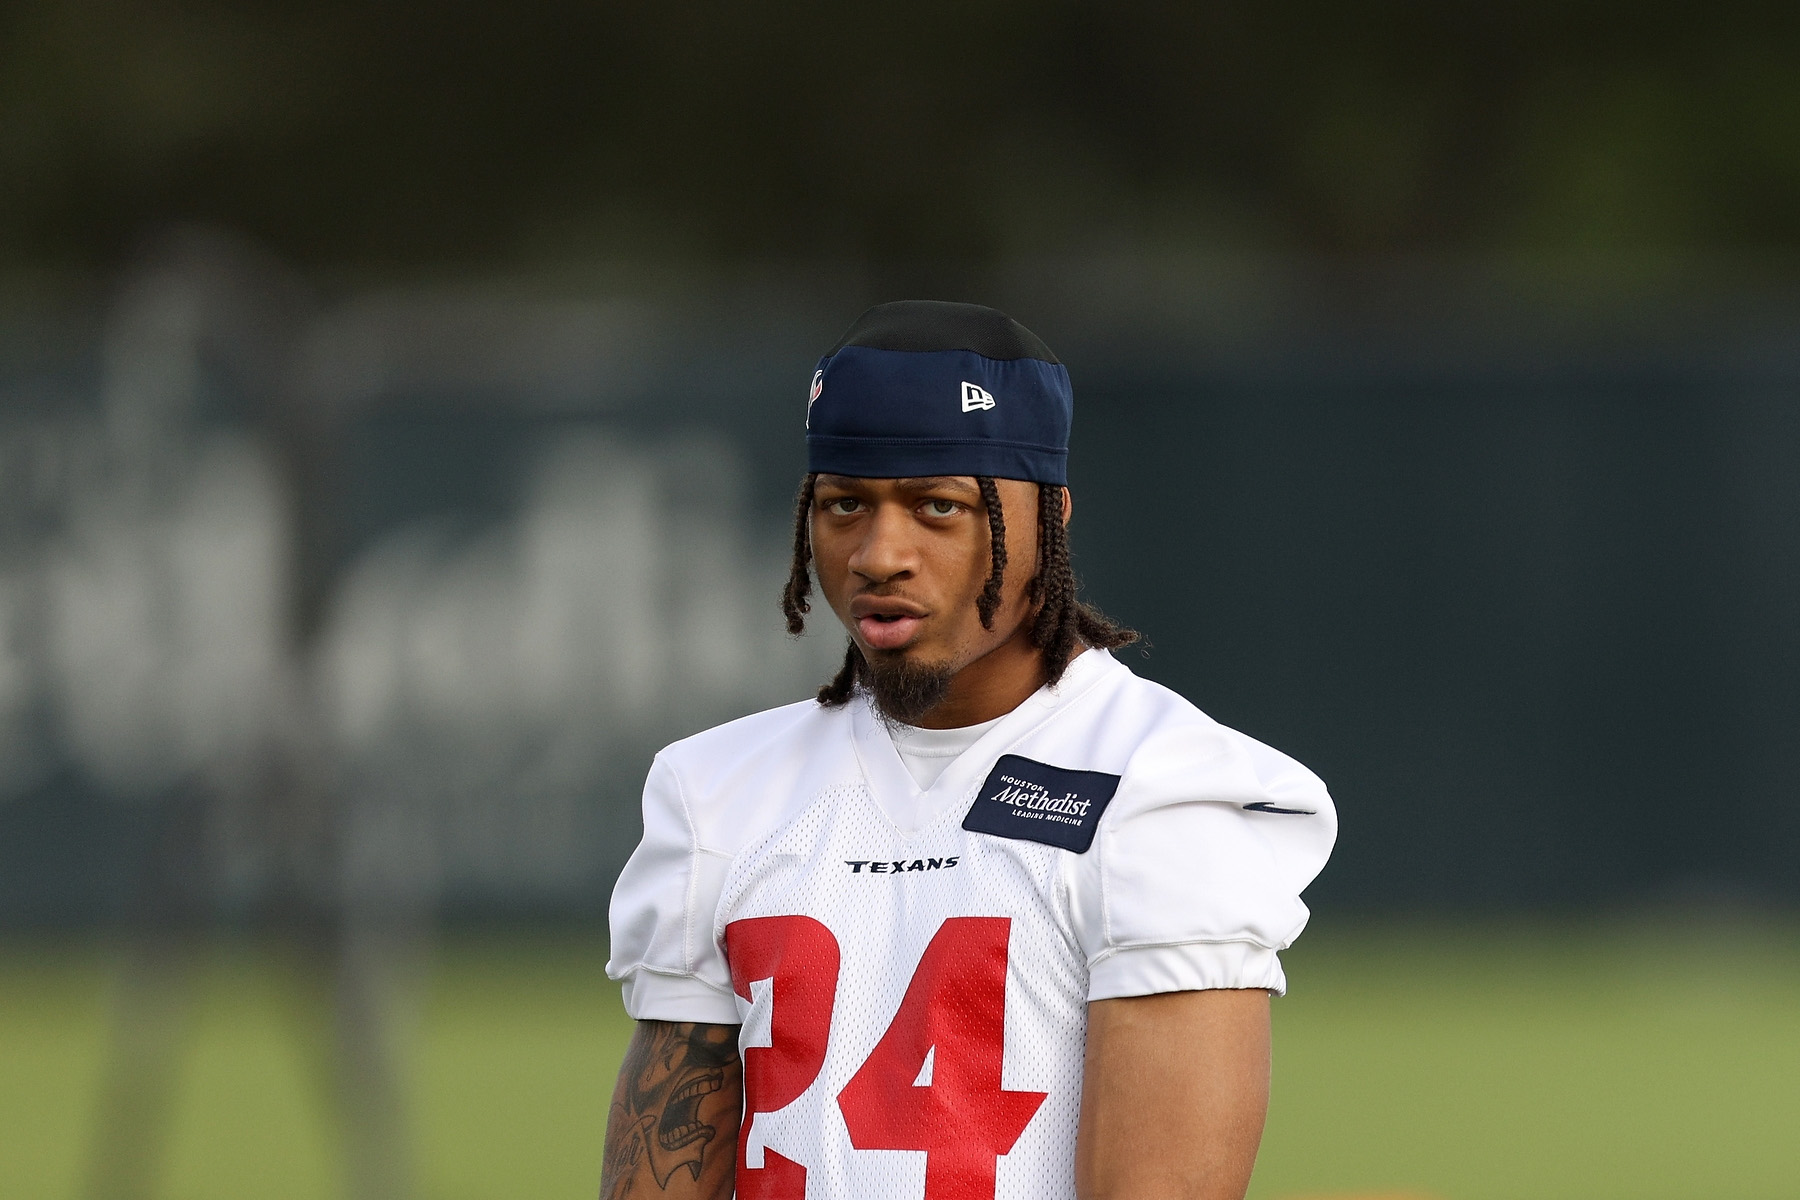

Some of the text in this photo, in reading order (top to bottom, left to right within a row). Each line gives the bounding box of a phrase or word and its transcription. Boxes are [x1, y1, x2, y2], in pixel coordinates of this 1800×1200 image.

[1000, 775, 1044, 792] HOUSTON
[991, 785, 1091, 817] Methodist
[1012, 809, 1083, 827] LEADING MEDICINE
[844, 856, 960, 874] TEXANS
